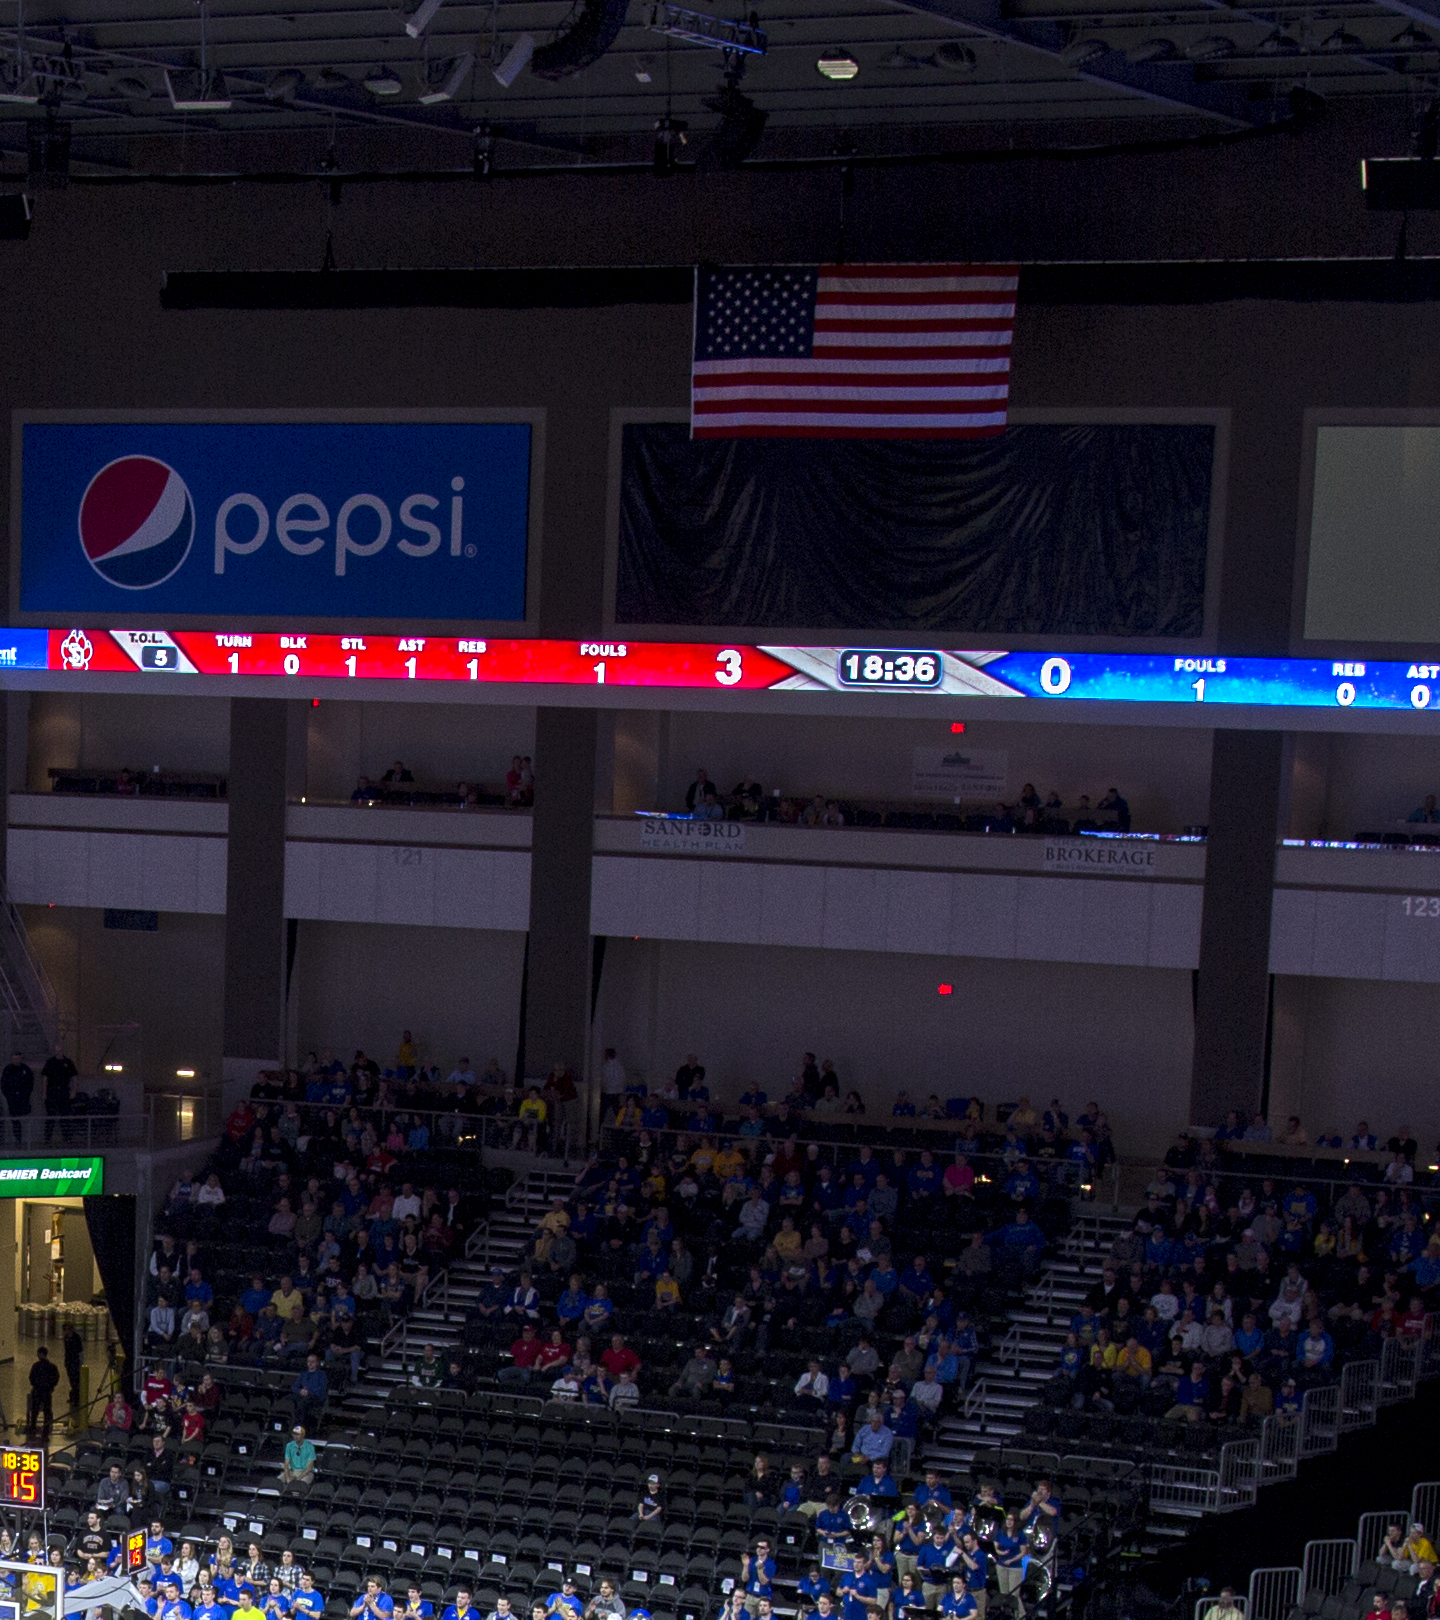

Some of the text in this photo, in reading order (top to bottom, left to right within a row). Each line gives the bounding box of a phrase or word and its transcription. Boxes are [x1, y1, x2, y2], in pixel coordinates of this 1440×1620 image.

[214, 476, 466, 577] pepsi
[128, 632, 163, 644] T.O.L.
[215, 635, 253, 648] TURN
[280, 636, 307, 649] BLK
[341, 638, 367, 651] STL
[398, 639, 426, 652] AST
[458, 641, 487, 653] REB
[154, 651, 168, 667] 5
[580, 643, 627, 658] FOULS
[227, 653, 239, 674] 1
[283, 654, 300, 676] 0
[345, 656, 357, 677] 1
[405, 658, 417, 679] 1
[467, 659, 478, 680] 1
[594, 662, 607, 684] 1
[715, 649, 743, 686] 3
[845, 653, 936, 683] 18:36
[1174, 658, 1227, 673] FOULS
[1332, 663, 1366, 677] REB
[1406, 665, 1440, 679] AST
[1039, 657, 1072, 695] 0
[1191, 678, 1206, 702] 1
[1336, 682, 1356, 707] 0
[1410, 684, 1430, 709] 0
[643, 819, 743, 839] SANFORD
[392, 849, 424, 867] 121
[1045, 846, 1156, 867] BROKERAGE
[40, 1167, 92, 1181] Bankcard
[2, 1453, 40, 1472] 18:36
[11, 1472, 37, 1501] 15
